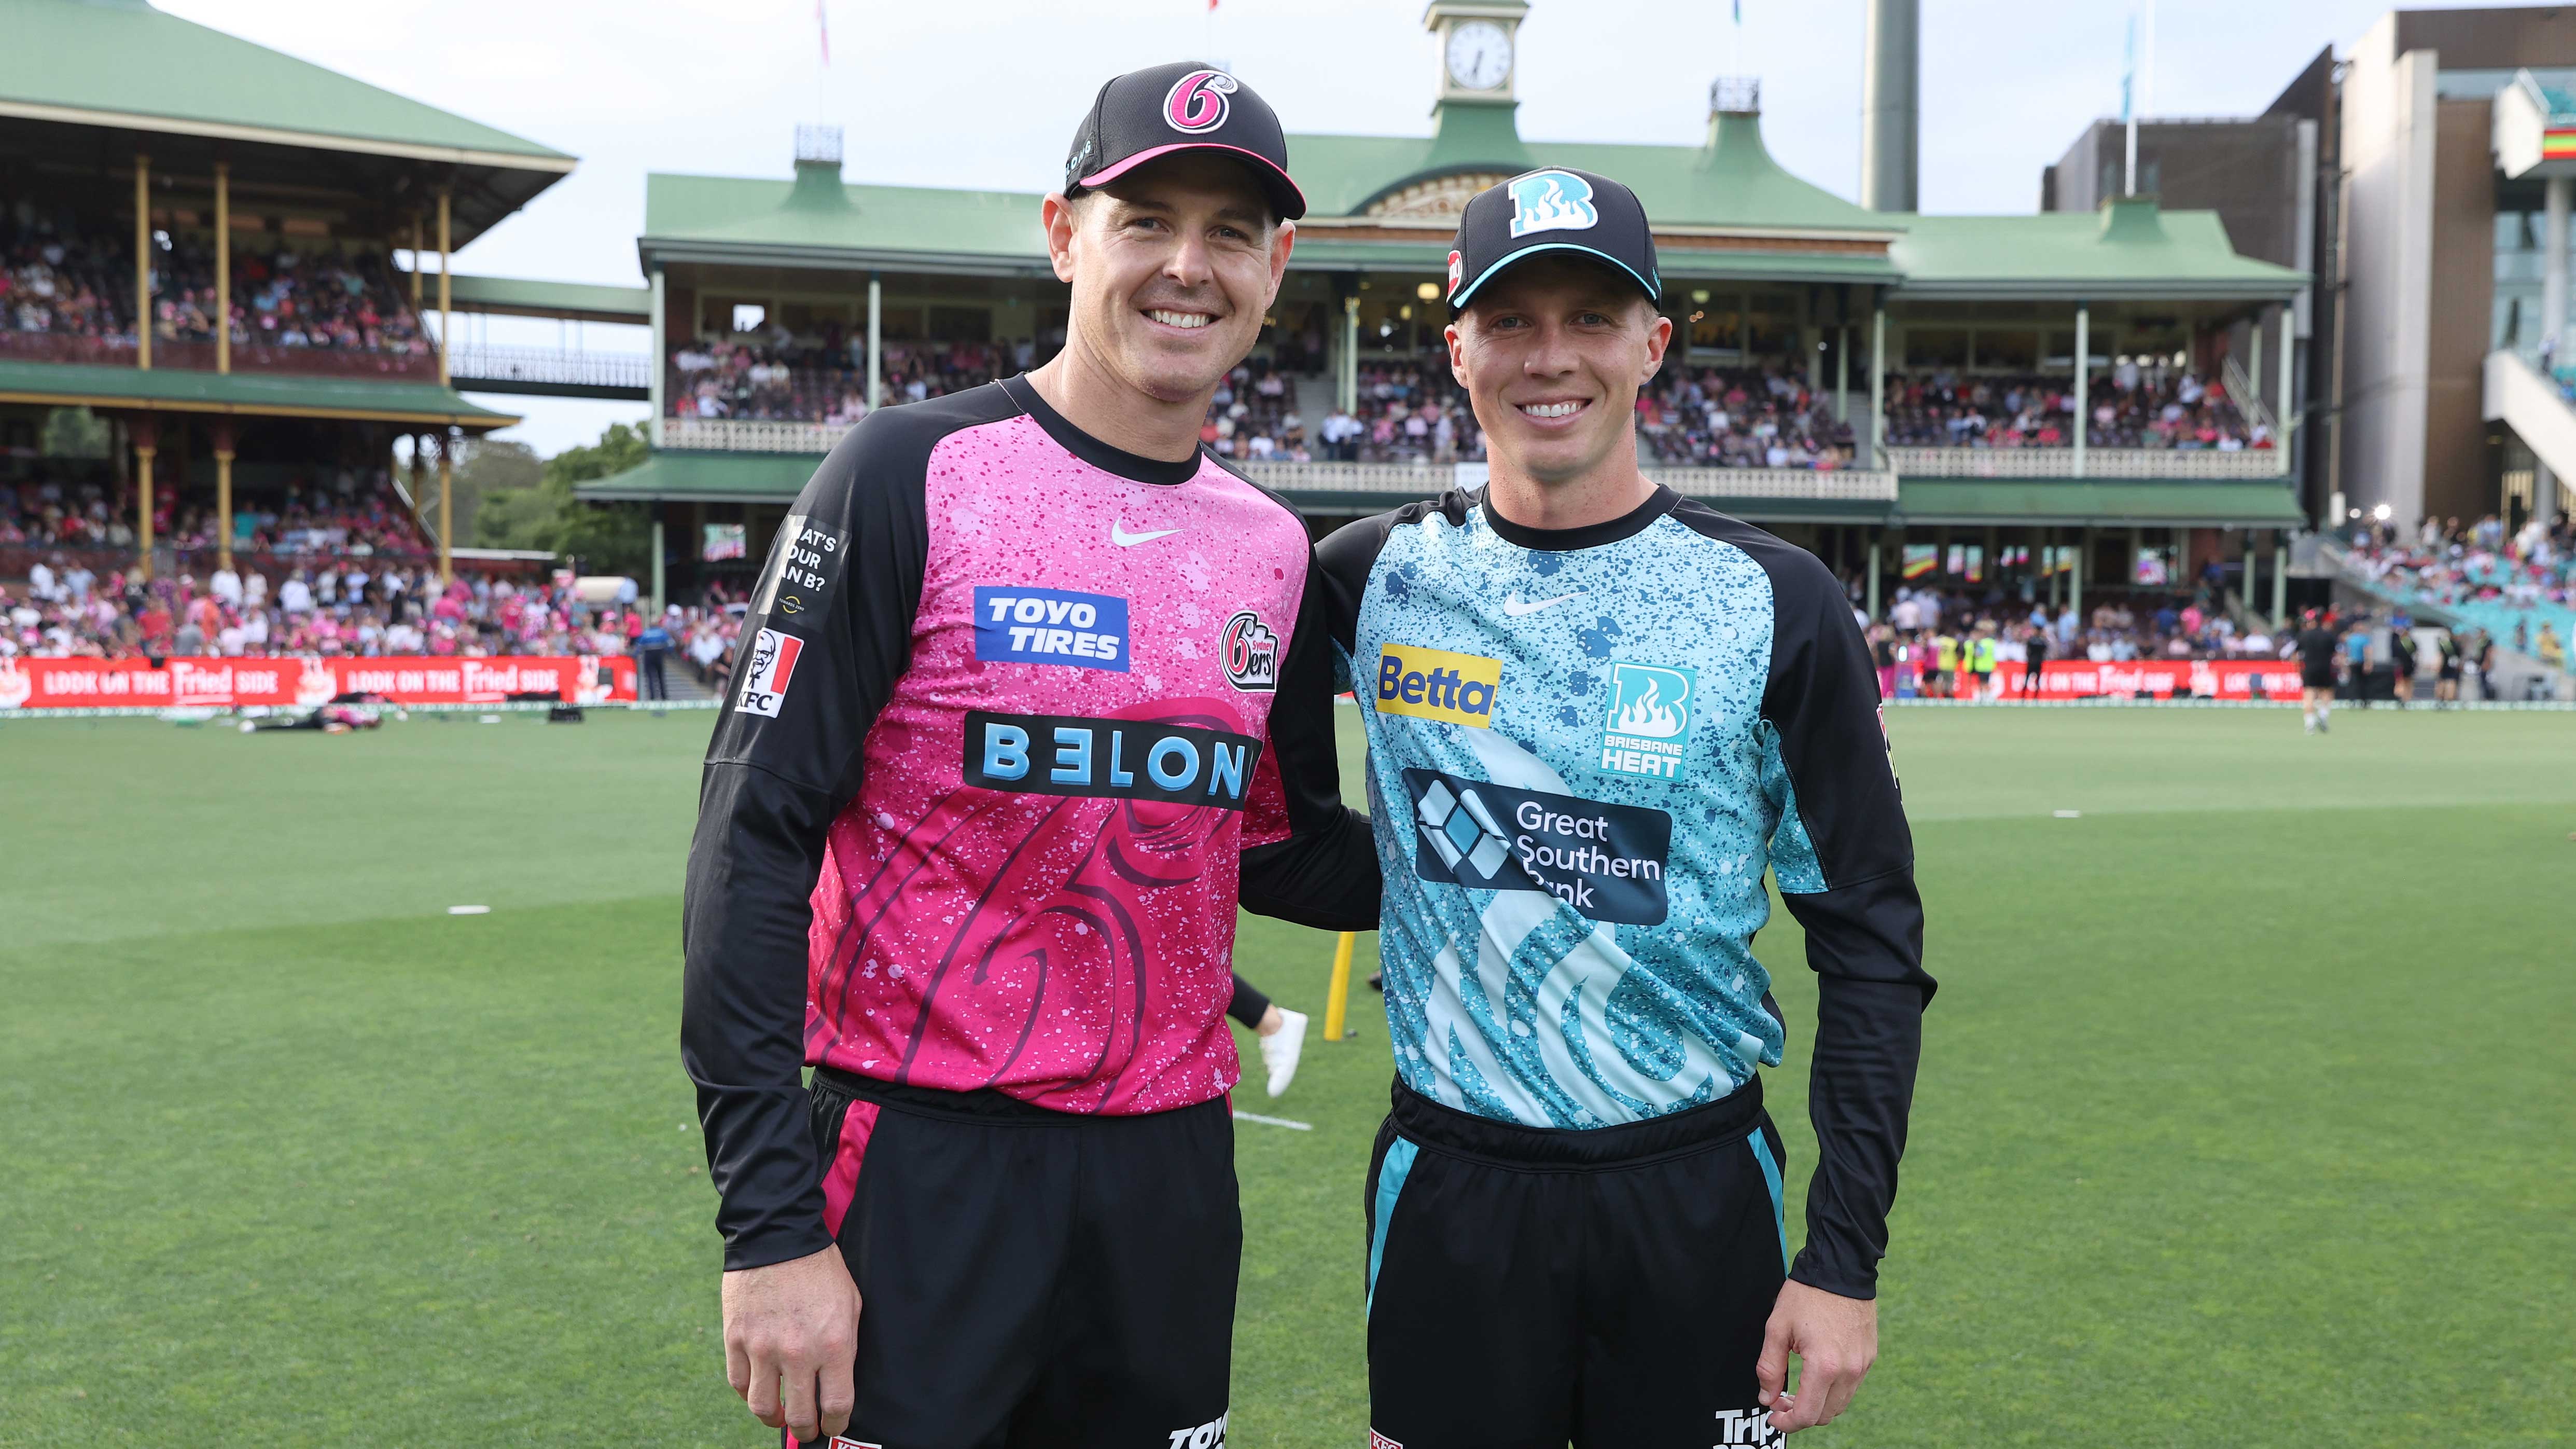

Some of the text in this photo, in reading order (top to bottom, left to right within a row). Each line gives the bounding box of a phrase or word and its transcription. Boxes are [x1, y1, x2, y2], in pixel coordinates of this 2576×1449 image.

[1163, 70, 1238, 134] 6
[1066, 140, 1091, 176] LONG
[788, 526, 837, 552] HAT'S
[788, 544, 821, 569] OUR
[803, 572, 825, 591] B?
[779, 598, 795, 608] TOWARDS
[988, 597, 1096, 628] TOYO
[1008, 626, 1120, 660] TIRES
[1252, 640, 1273, 652] Sydney
[43, 661, 279, 698] LOOK ON THE Fried SIDE
[346, 661, 559, 697] LOOK ON THE Fried SIDE
[1379, 655, 1495, 715] Betta
[736, 691, 773, 711] KFC
[983, 722, 1245, 799] BELON
[1604, 735, 1683, 756] BRISBANE
[1601, 748, 1681, 778] HEAT
[1516, 801, 1608, 842] Great
[1517, 835, 1660, 880] Southern
